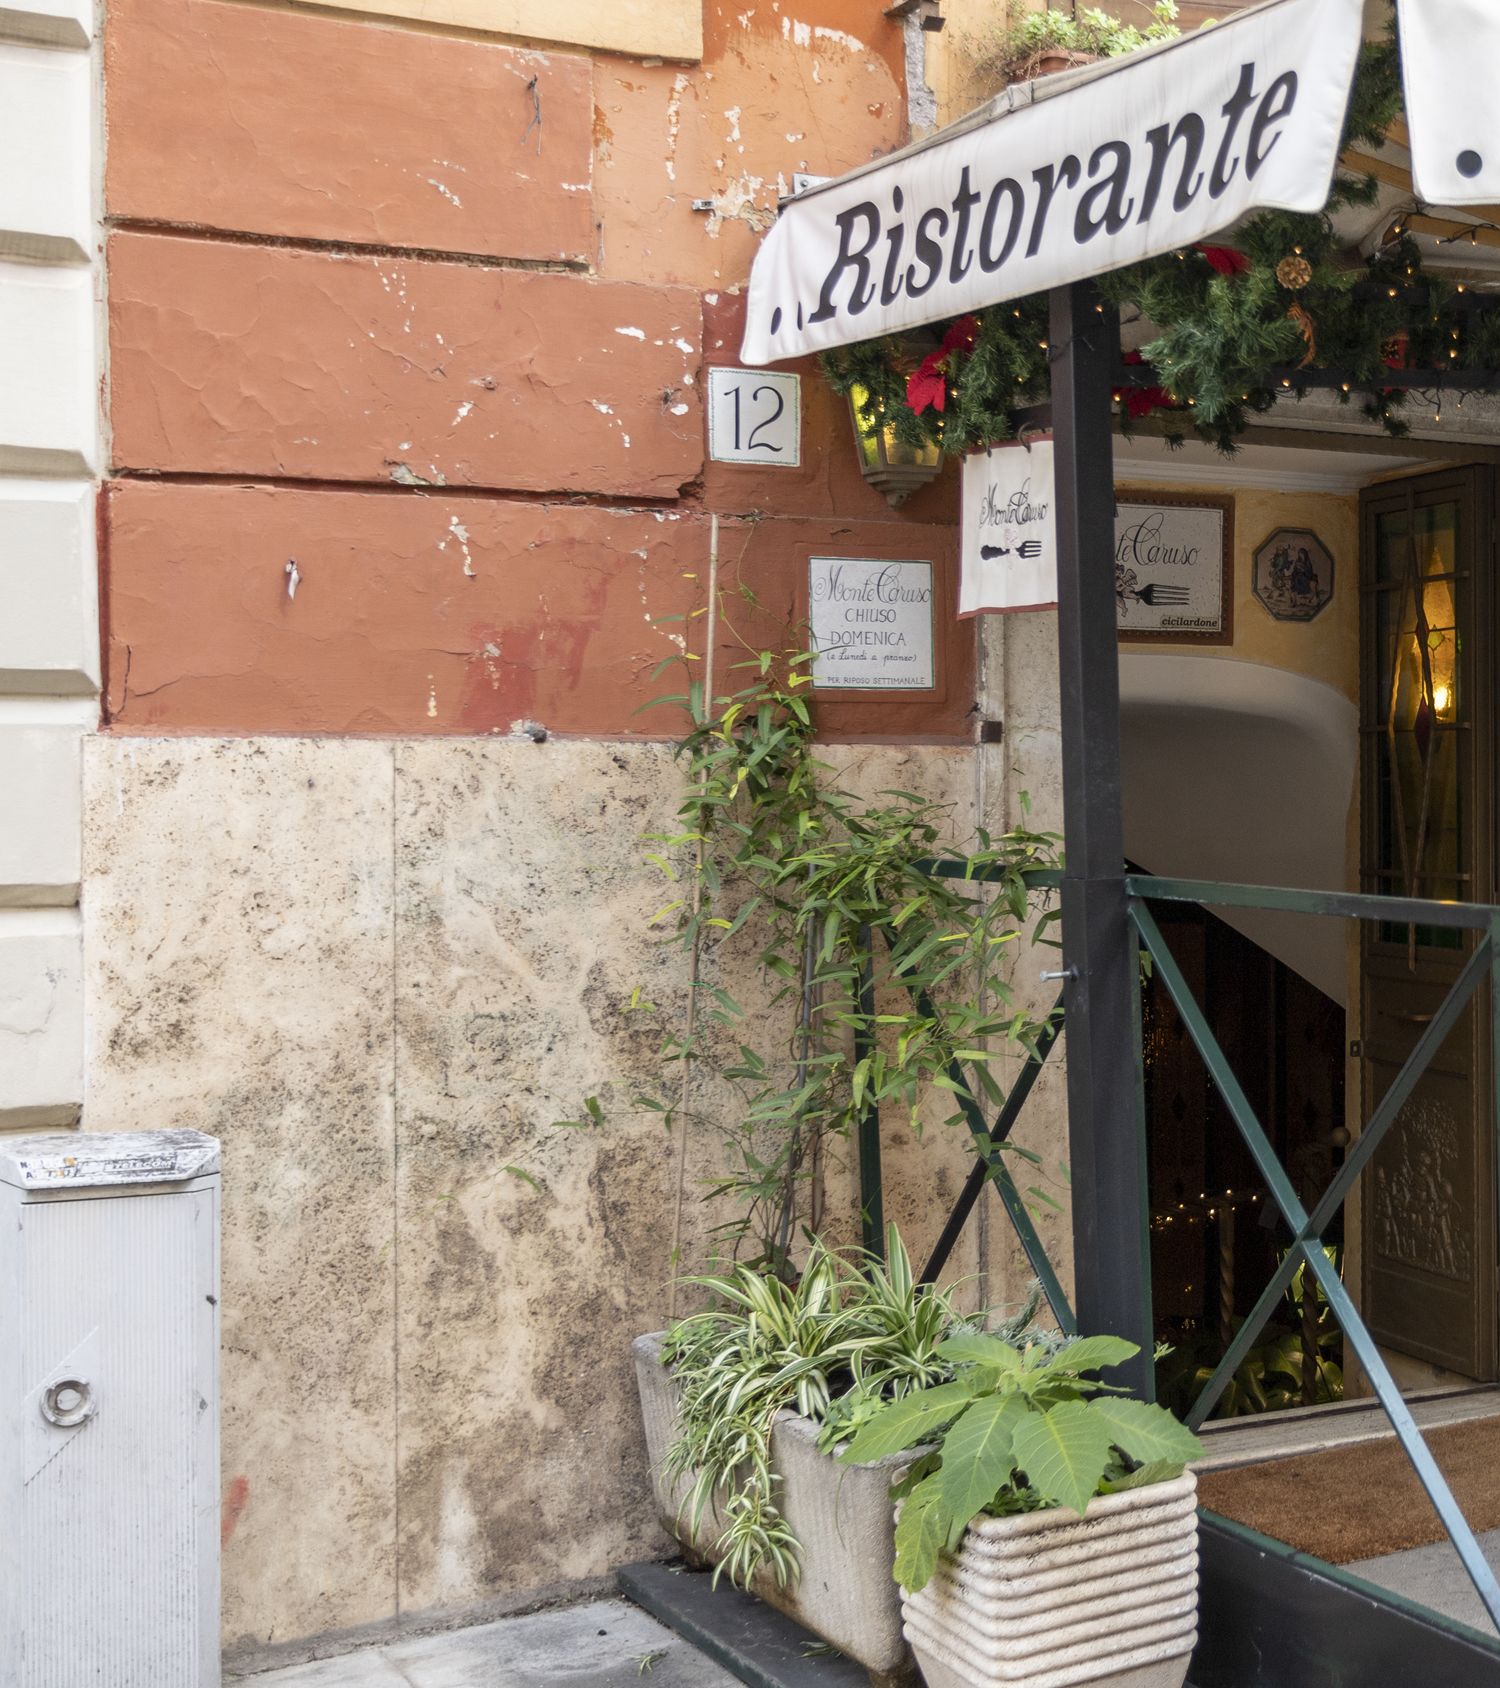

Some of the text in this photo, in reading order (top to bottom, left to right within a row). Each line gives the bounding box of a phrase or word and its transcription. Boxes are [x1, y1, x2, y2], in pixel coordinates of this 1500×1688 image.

[723, 385, 785, 453] 12
[1125, 512, 1201, 567] Caruso
[814, 563, 931, 605] Monte Caruso
[844, 608, 897, 623] CHIUSO
[1161, 616, 1218, 628] cicilardone
[830, 631, 906, 646] DOMENICA
[843, 676, 870, 685] RIPOSO
[872, 677, 926, 686] SETTIMANALE
